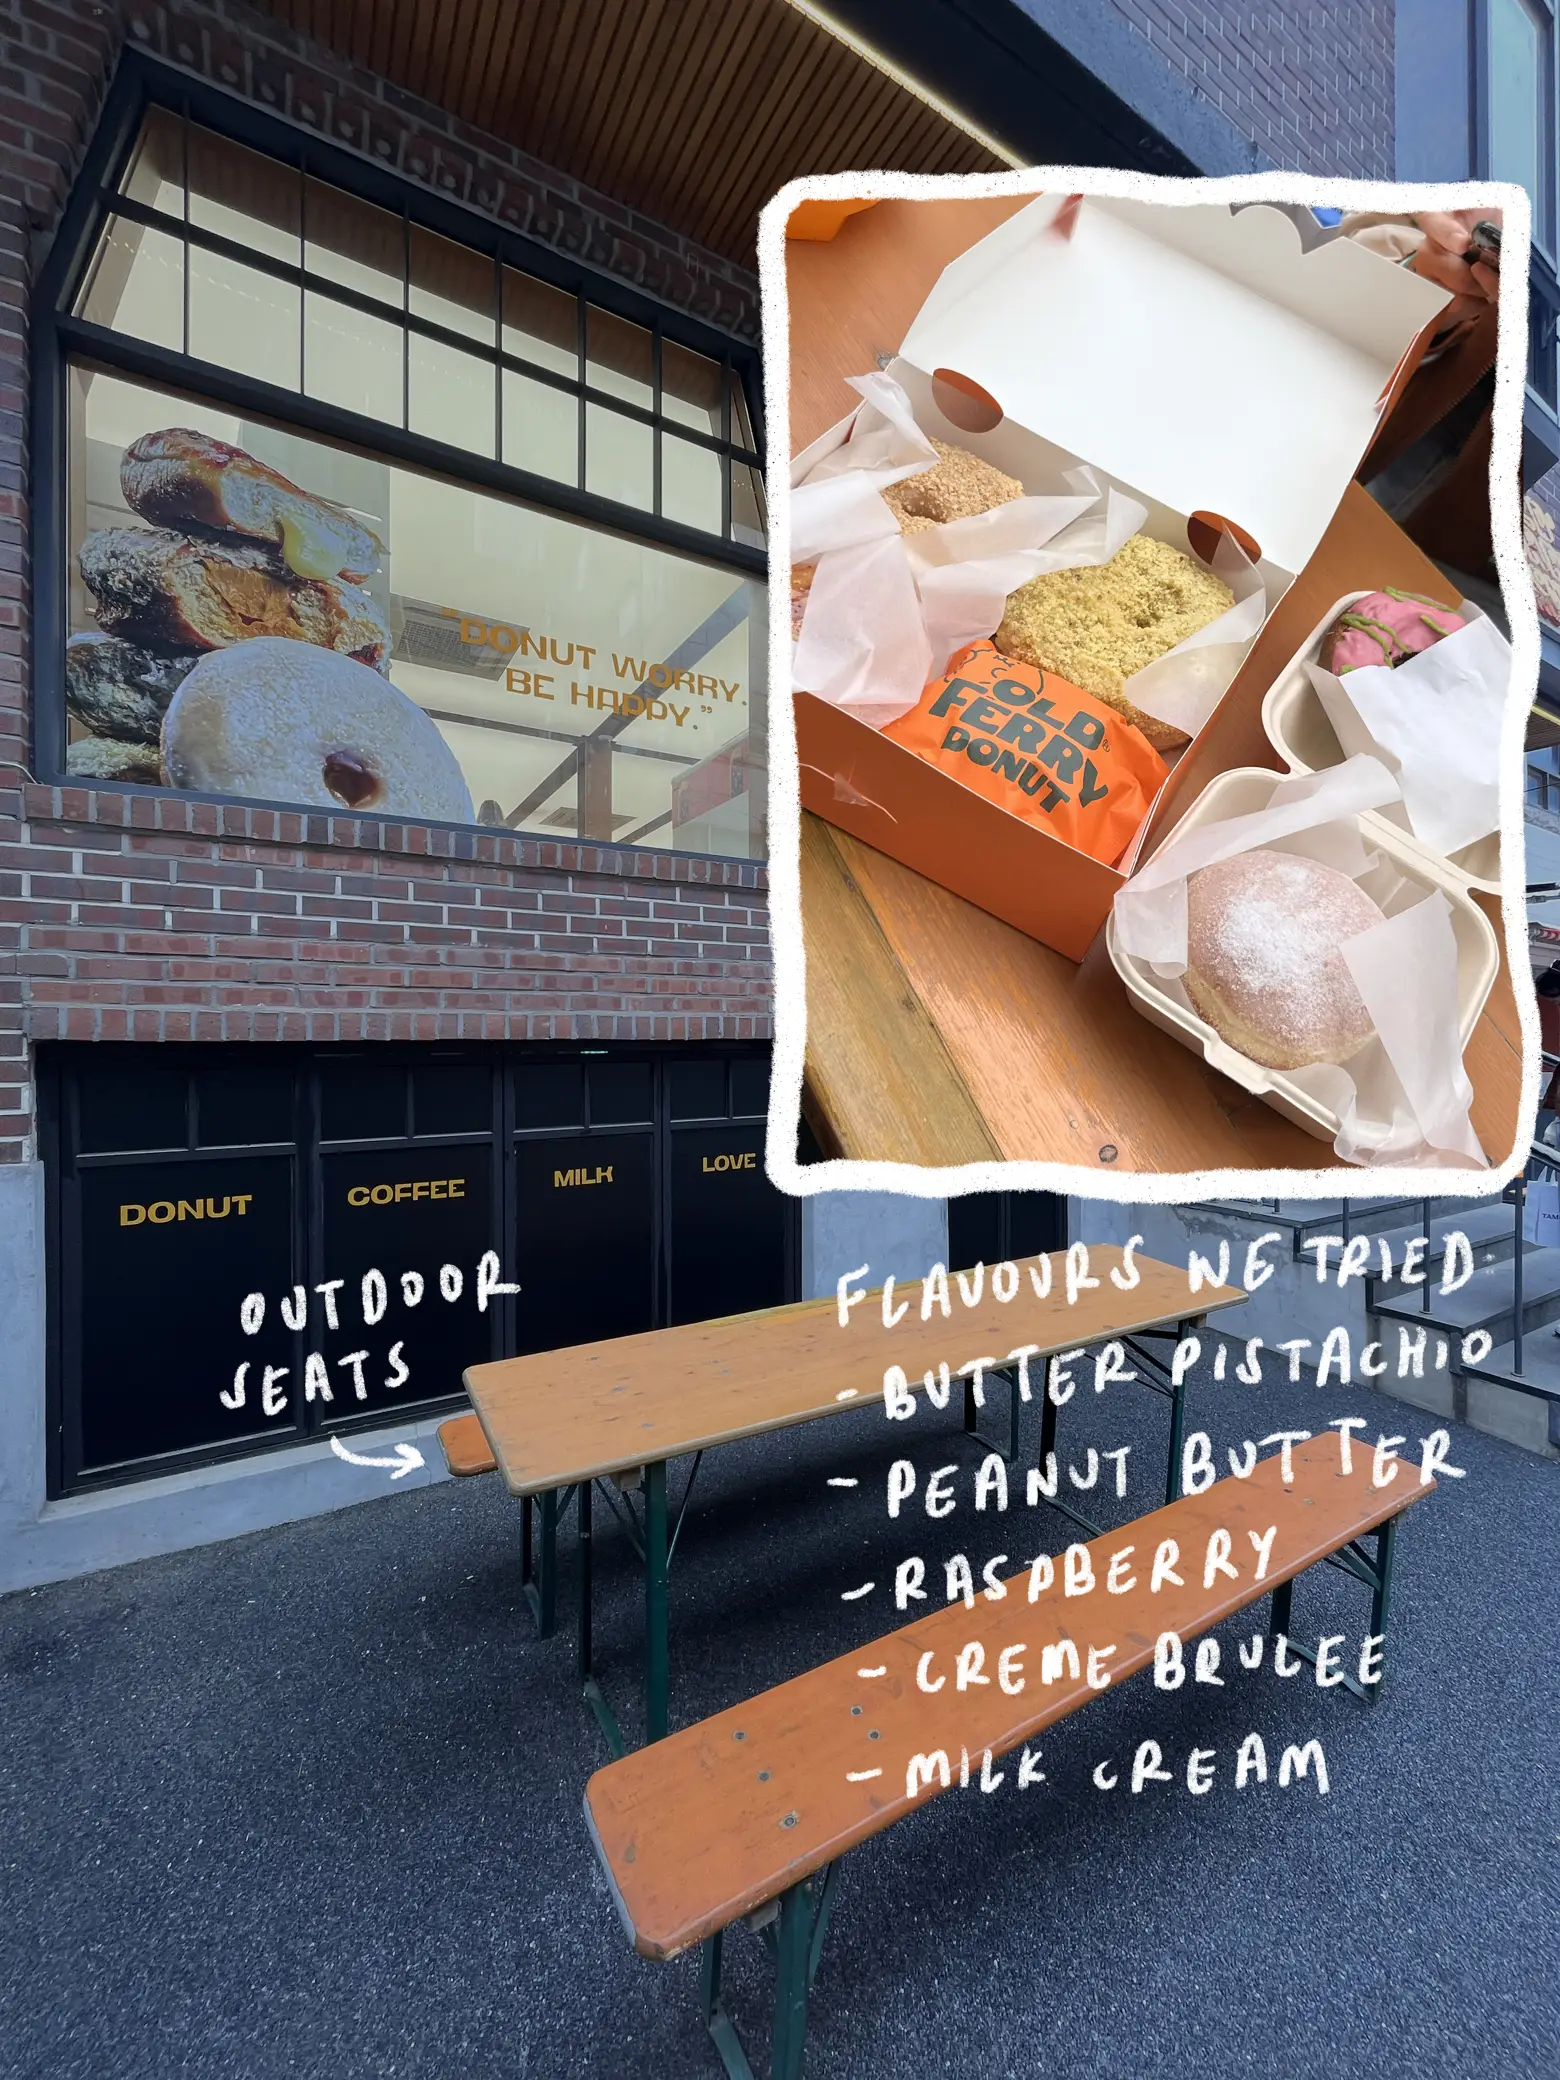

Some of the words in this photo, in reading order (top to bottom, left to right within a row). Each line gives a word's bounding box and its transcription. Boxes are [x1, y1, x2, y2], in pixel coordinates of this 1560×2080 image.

[506, 668, 555, 700] BE
[611, 653, 748, 706] WORRY.
[992, 678, 1106, 751] OLD
[928, 677, 1109, 808] FERRY
[940, 725, 1071, 813] DONUT
[553, 1165, 614, 1189] MILK
[702, 1152, 757, 1174] LOVE
[347, 1179, 466, 1207] COFFEE
[119, 1194, 253, 1227] DONUT
[1541, 1212, 1560, 1220] TAM
